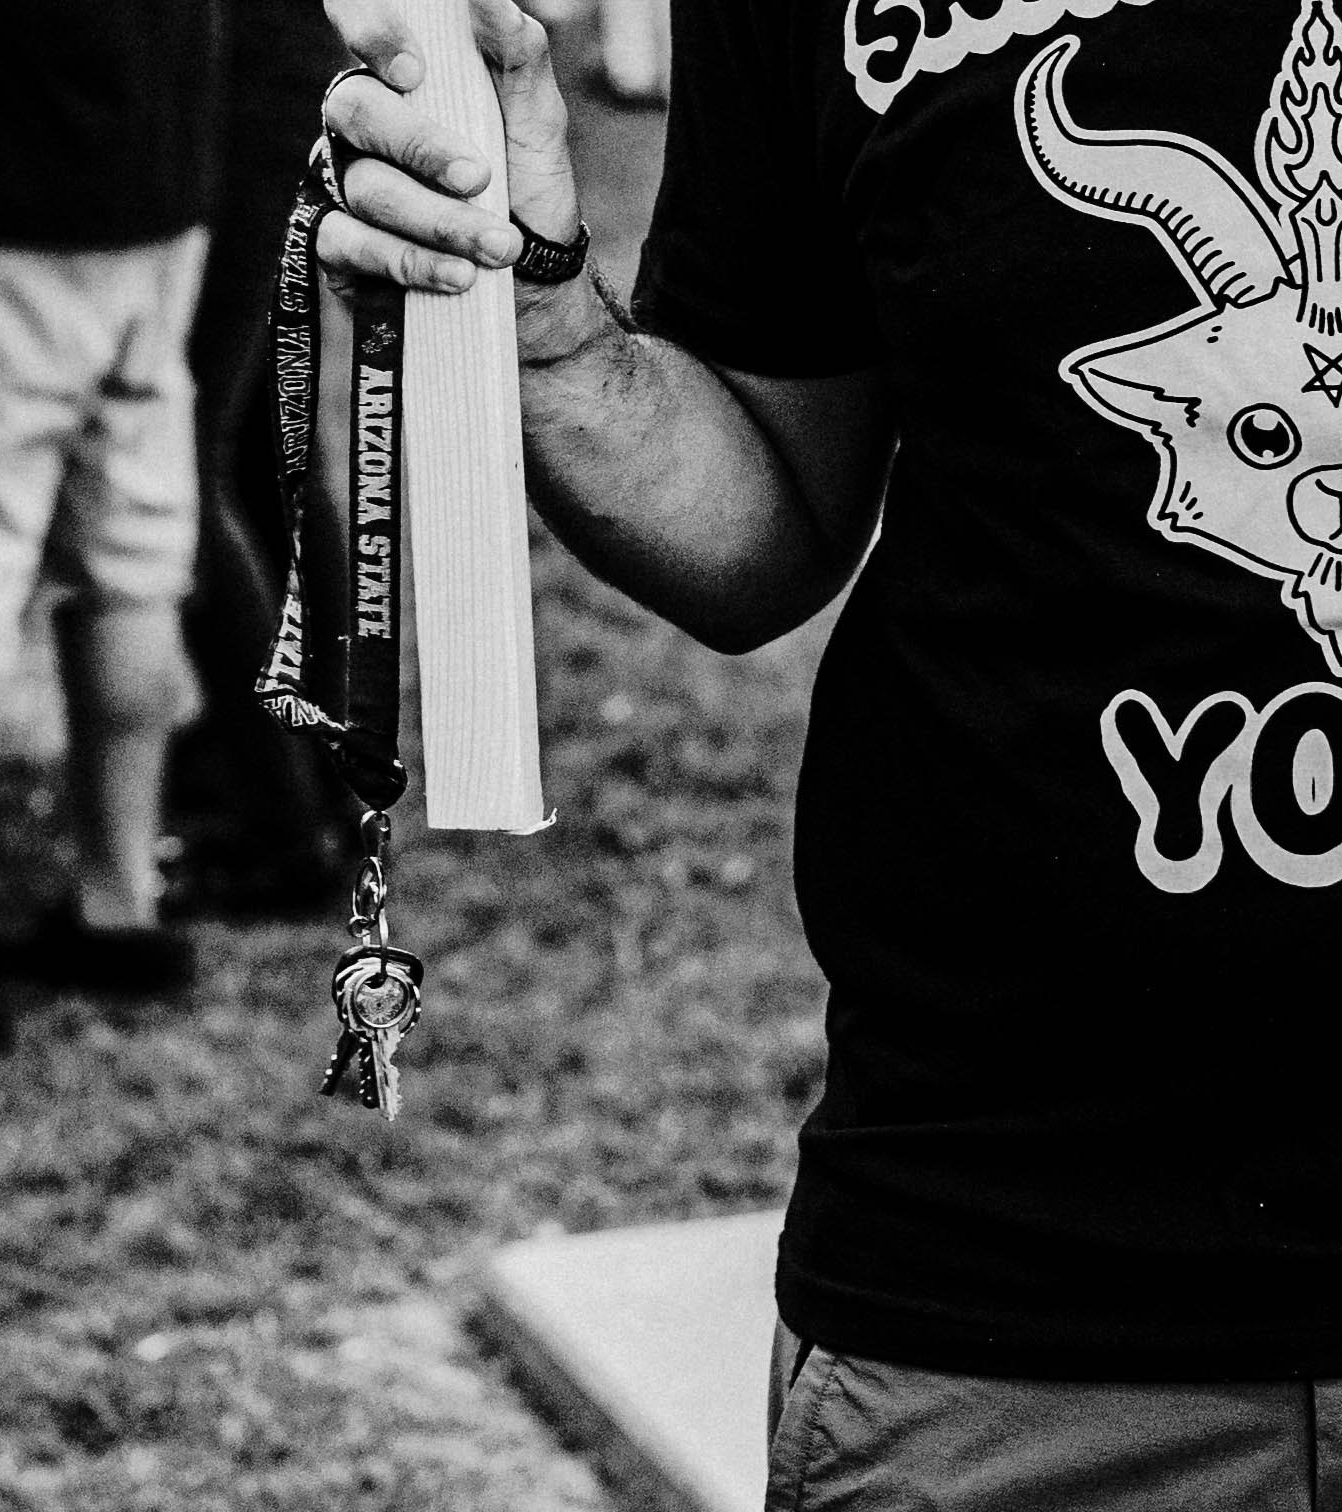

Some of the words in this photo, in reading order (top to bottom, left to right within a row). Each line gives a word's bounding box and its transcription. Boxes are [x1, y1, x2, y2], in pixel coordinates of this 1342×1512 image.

[276, 326, 311, 474] ARIZONA
[358, 365, 393, 525] ARIZONA
[357, 534, 392, 639] STATE
